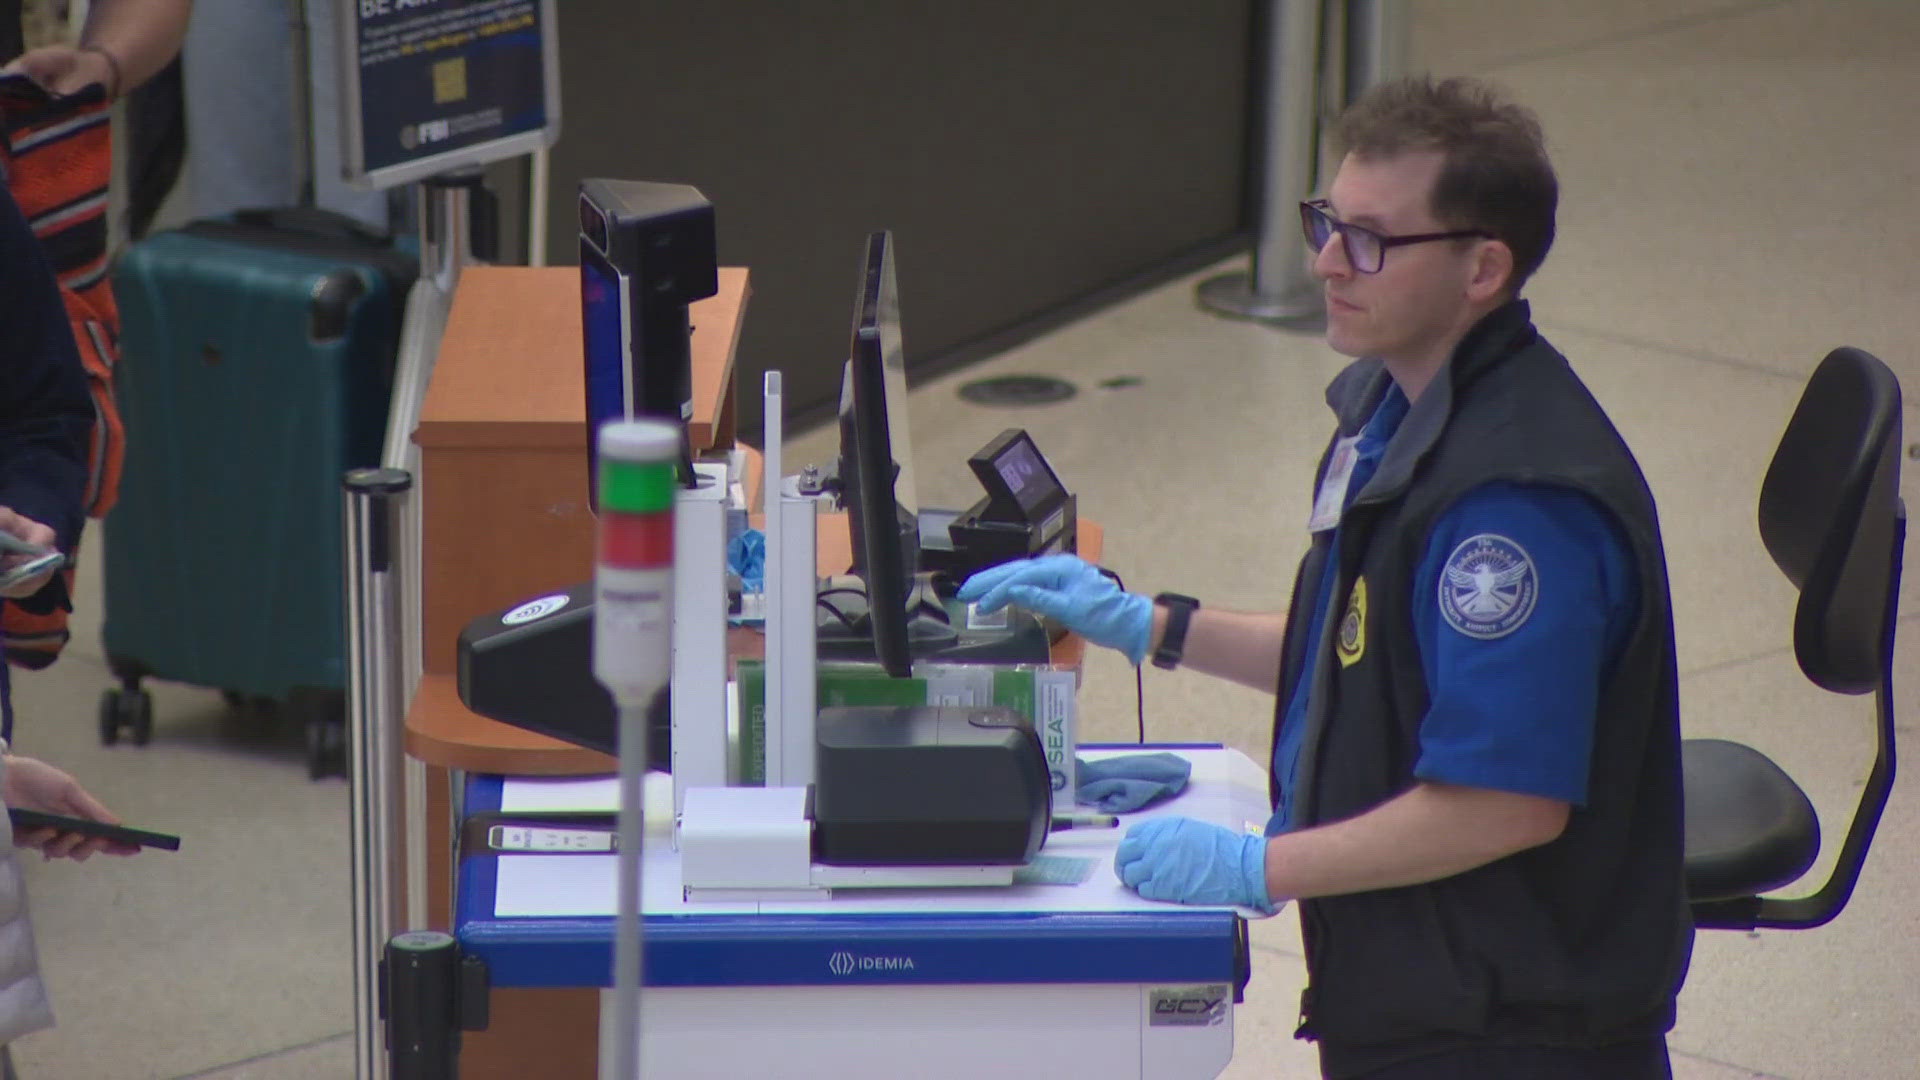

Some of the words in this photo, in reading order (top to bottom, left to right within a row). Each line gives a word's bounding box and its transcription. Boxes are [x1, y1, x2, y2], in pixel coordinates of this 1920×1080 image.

[418, 119, 449, 144] FBI
[1047, 717, 1065, 764] SEA
[858, 957, 914, 970] IDEMIA
